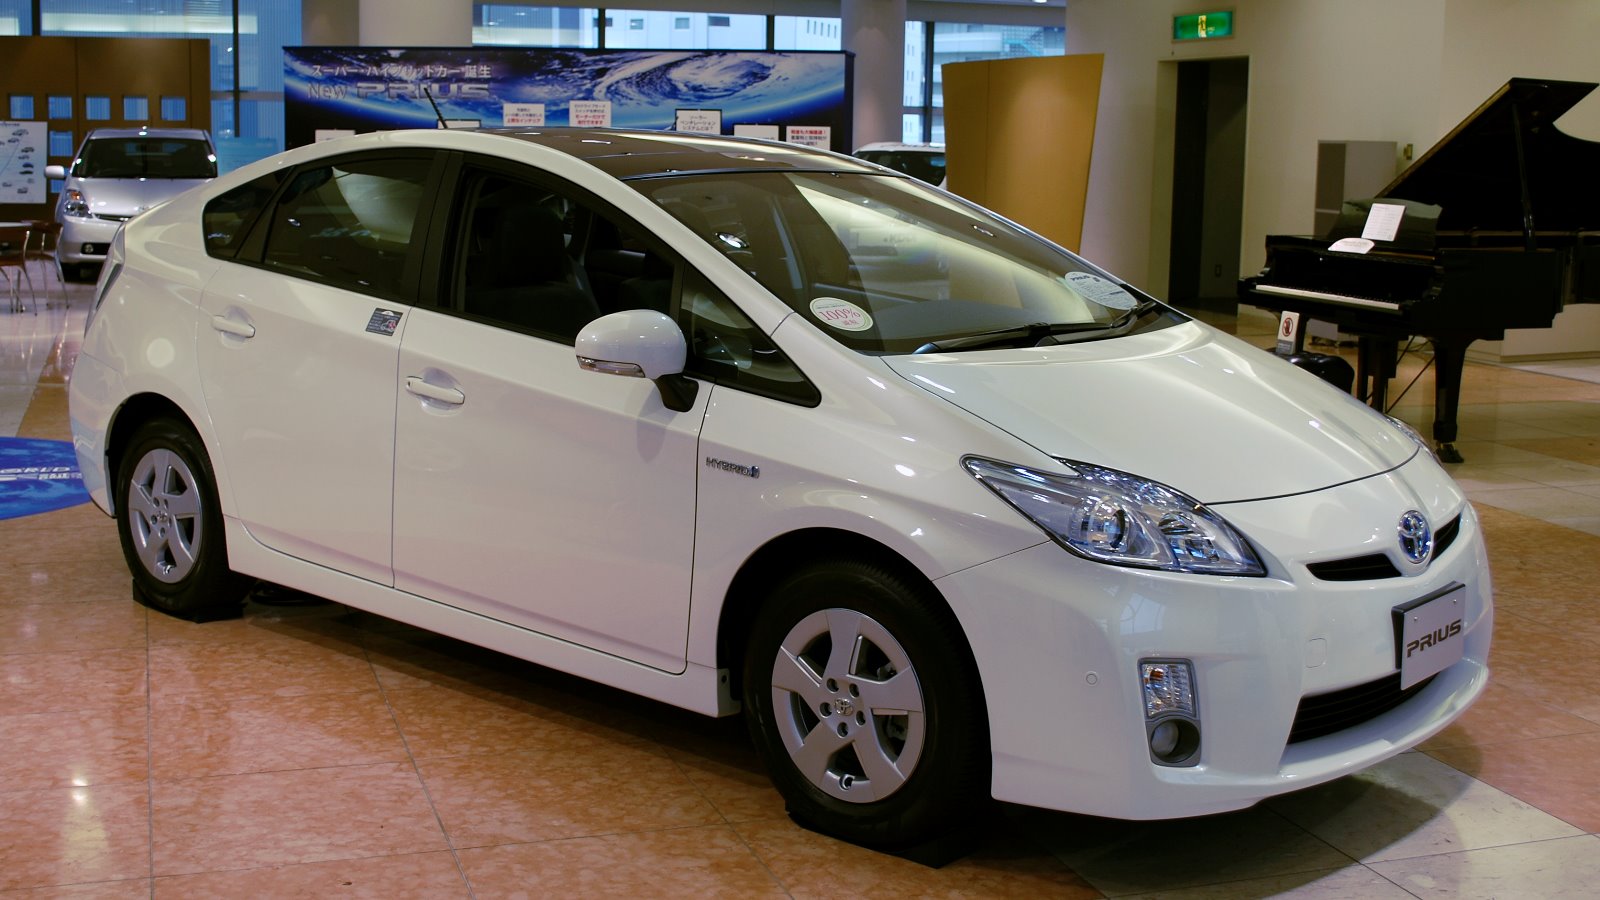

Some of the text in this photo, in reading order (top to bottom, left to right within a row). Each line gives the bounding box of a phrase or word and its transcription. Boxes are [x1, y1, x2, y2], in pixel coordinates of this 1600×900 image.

[307, 82, 490, 99] New PRIUS
[819, 308, 861, 321] 100%
[1406, 619, 1462, 658] PRIUS
